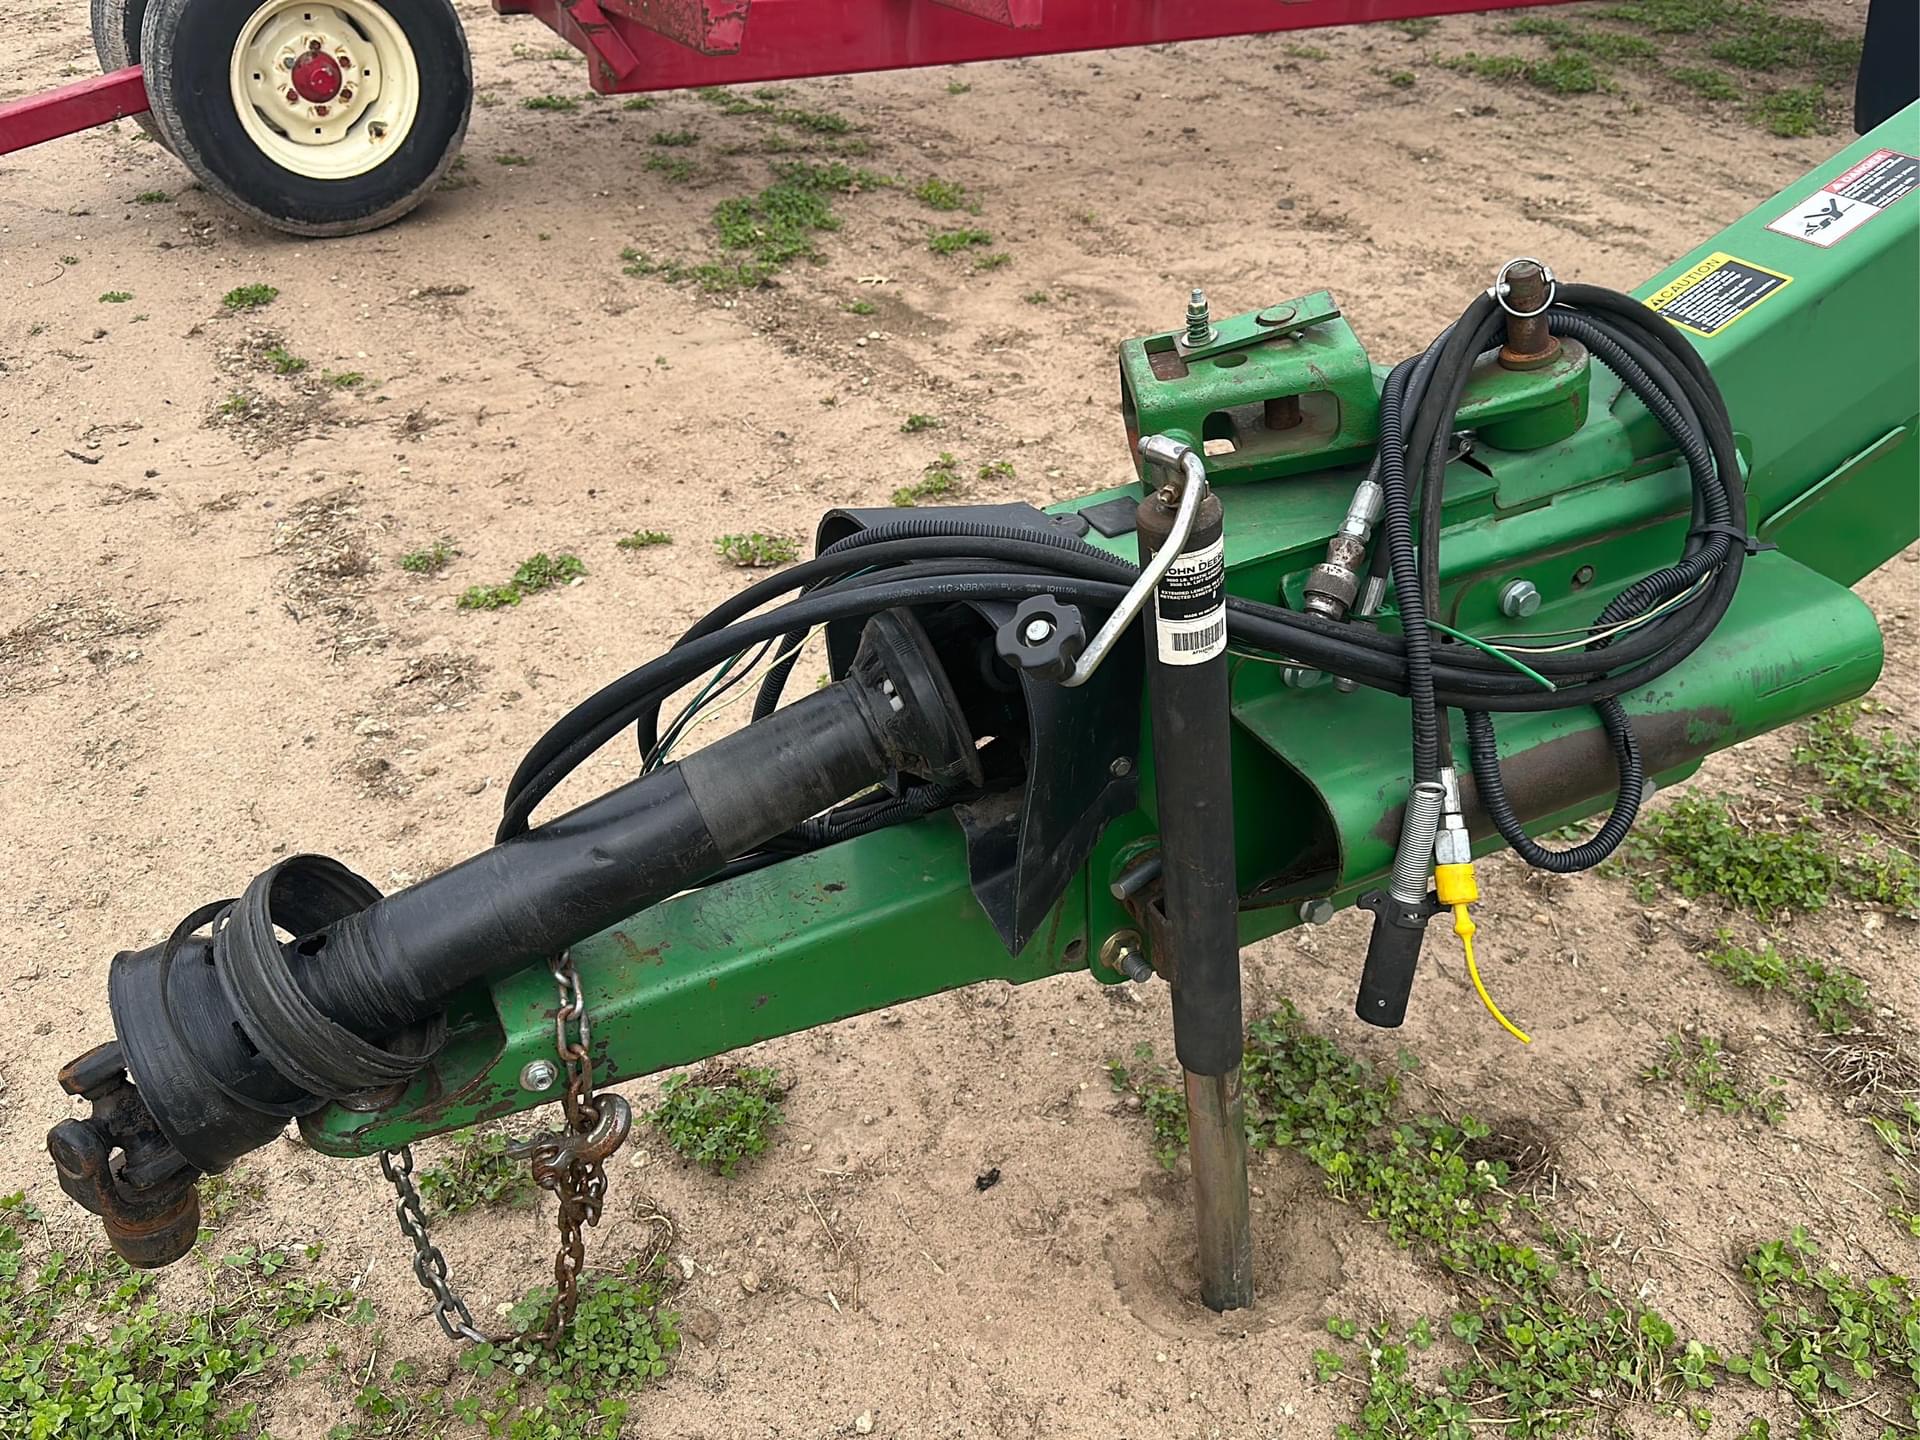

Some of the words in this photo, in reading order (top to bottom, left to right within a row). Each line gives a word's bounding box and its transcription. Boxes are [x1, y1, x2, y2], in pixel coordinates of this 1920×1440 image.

[1839, 153, 1886, 184] DANGER
[1660, 258, 1720, 298] CAUTION
[1166, 566, 1195, 575] OHN
